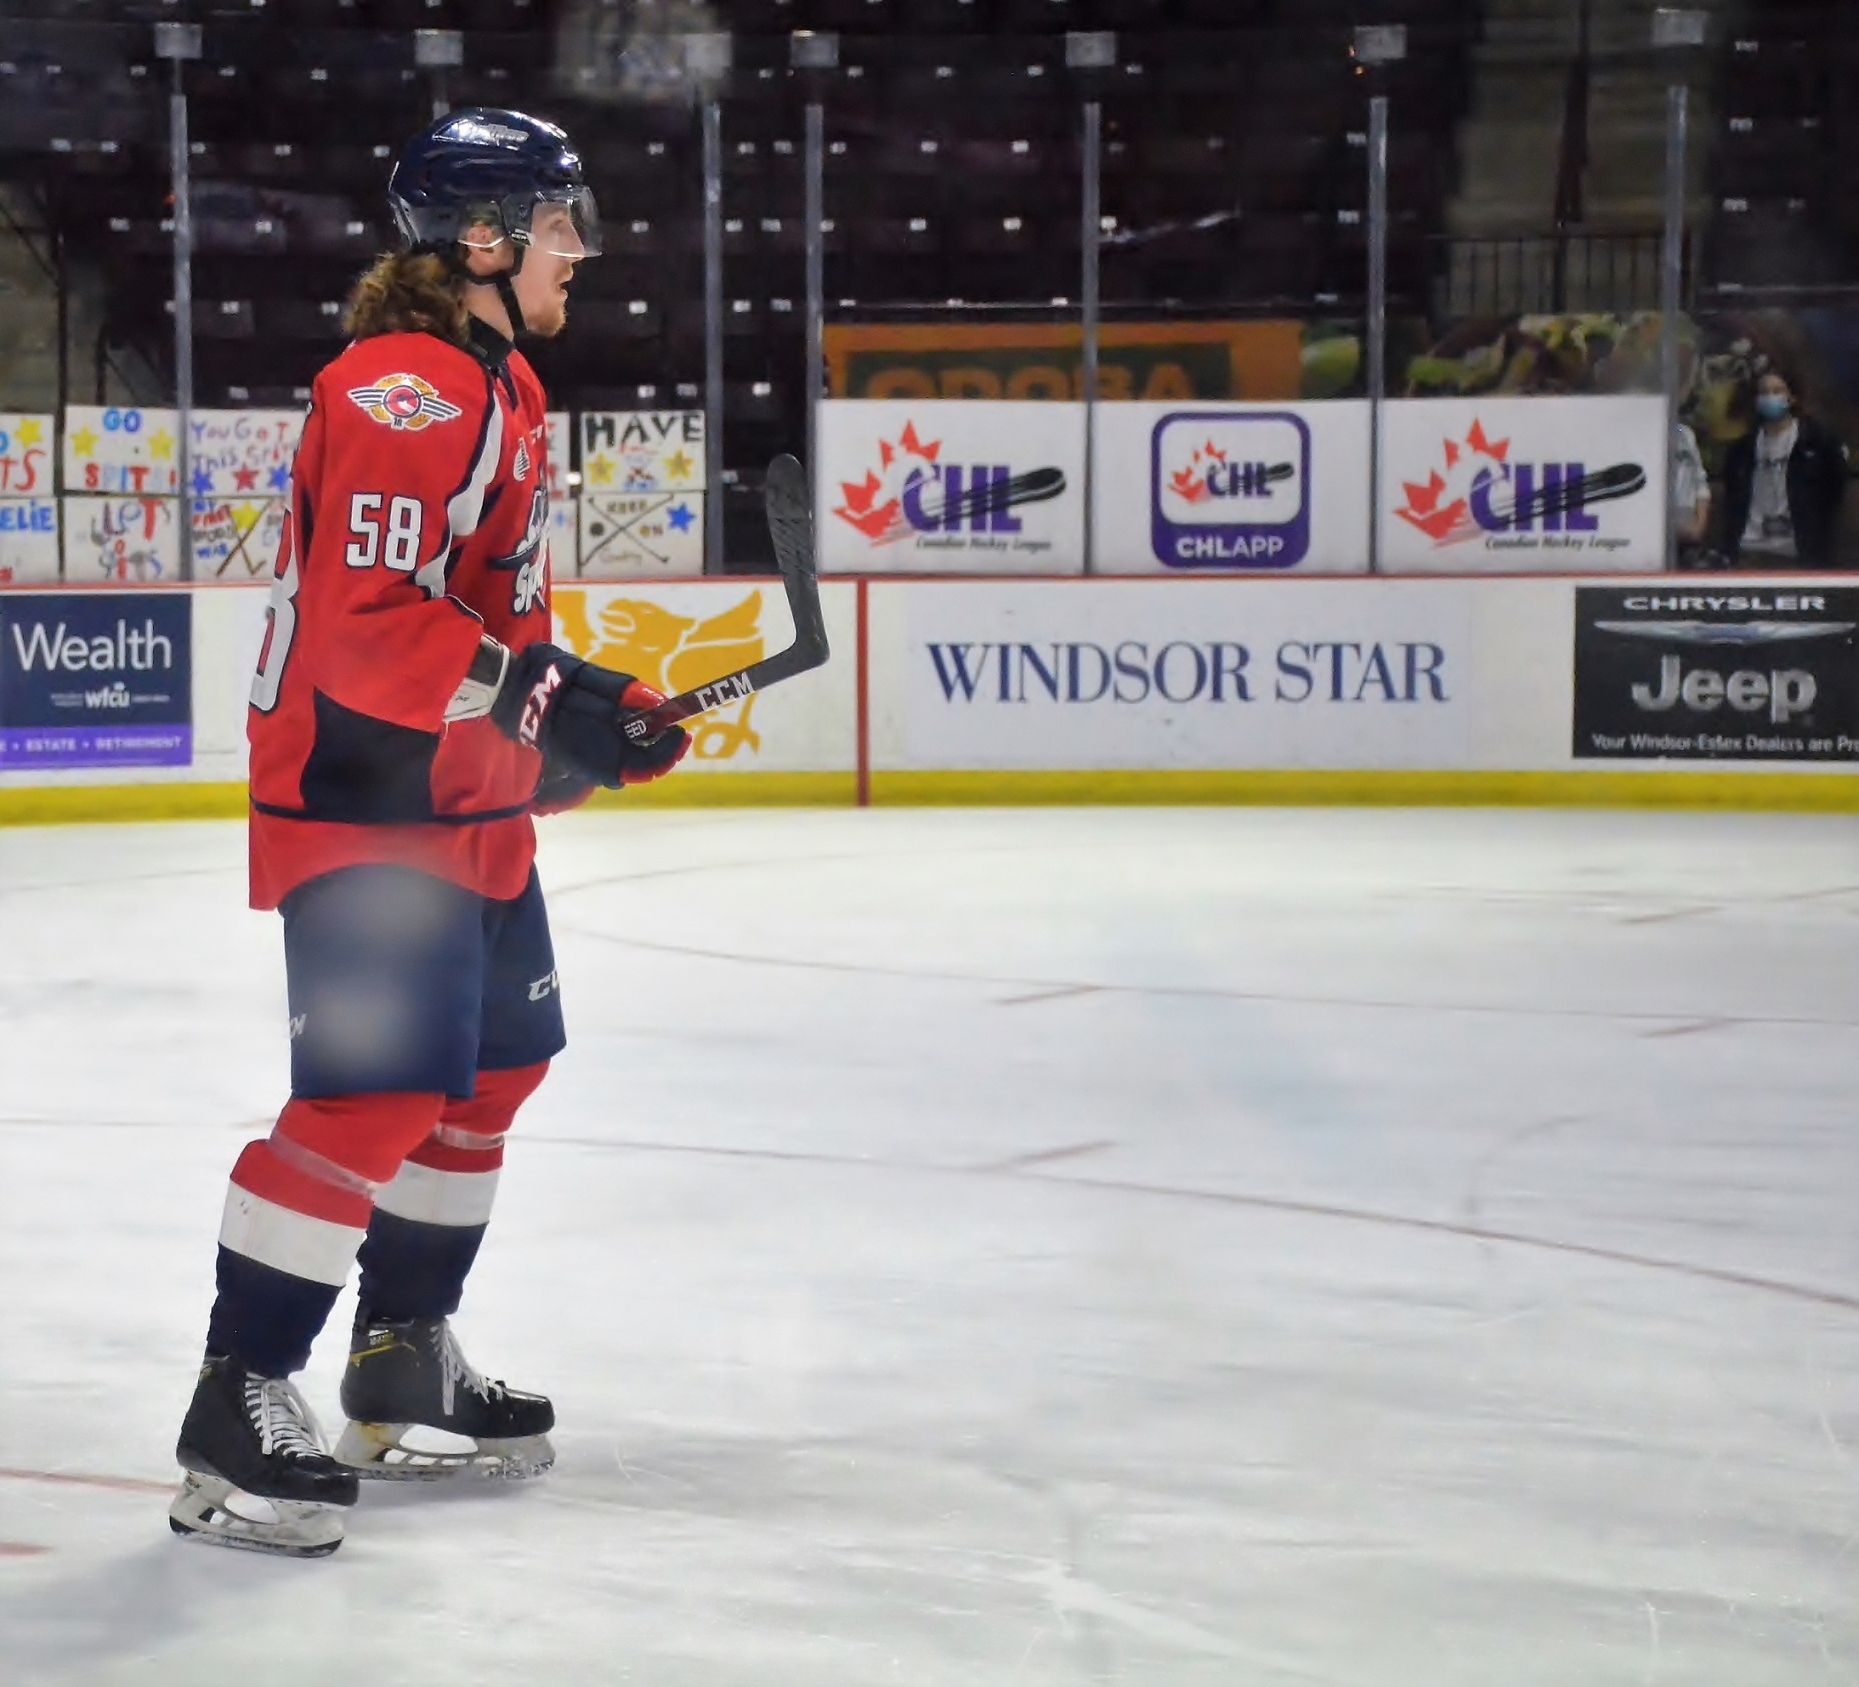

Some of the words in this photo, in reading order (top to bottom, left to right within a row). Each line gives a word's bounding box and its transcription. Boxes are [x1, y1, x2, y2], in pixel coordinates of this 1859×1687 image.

[103, 408, 141, 433] GO
[585, 411, 702, 453] HAVE
[902, 463, 1022, 534] CHL
[1207, 461, 1273, 497] CHL
[1470, 462, 1598, 533] CHL
[346, 491, 423, 572] 58
[1623, 596, 1826, 611] CHRYSLER
[12, 619, 172, 671] Wealth
[694, 671, 755, 712] CCM
[926, 640, 1255, 704] WINDSOR
[1274, 640, 1450, 704] STAR
[1631, 654, 1818, 724] Jeep
[1592, 733, 1627, 750] Your
[1746, 734, 1804, 752] Dealers
[1809, 738, 1834, 752] are
